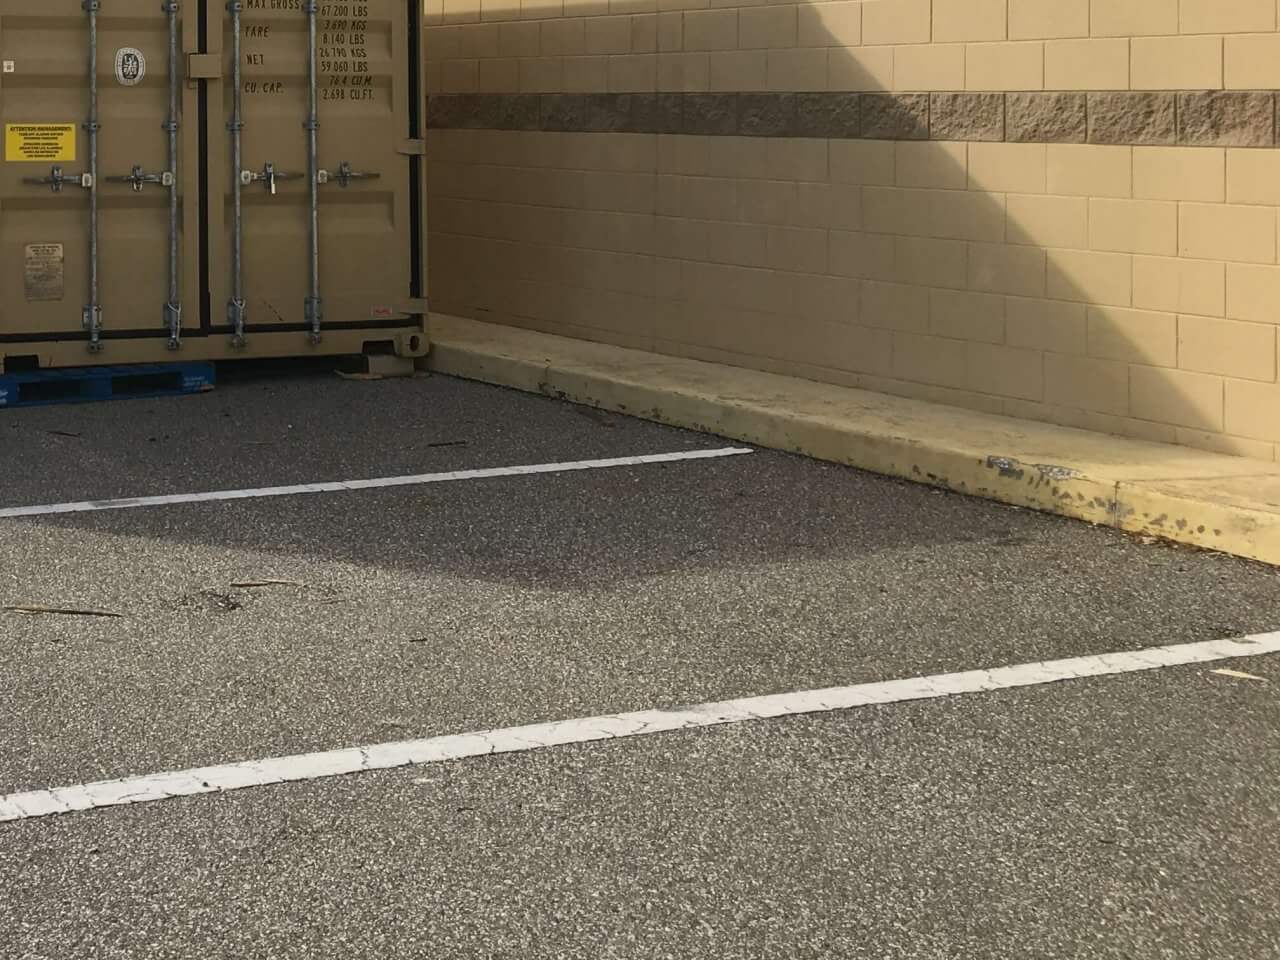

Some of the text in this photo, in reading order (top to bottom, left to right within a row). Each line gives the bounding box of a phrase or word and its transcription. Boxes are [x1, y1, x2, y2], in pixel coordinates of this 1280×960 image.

[352, 6, 368, 17] LBS
[350, 20, 367, 31] KGS
[245, 25, 270, 38] TARE
[349, 34, 365, 45] LBS
[351, 48, 367, 58] KGS
[246, 54, 264, 65] NET
[353, 61, 368, 73] LBS
